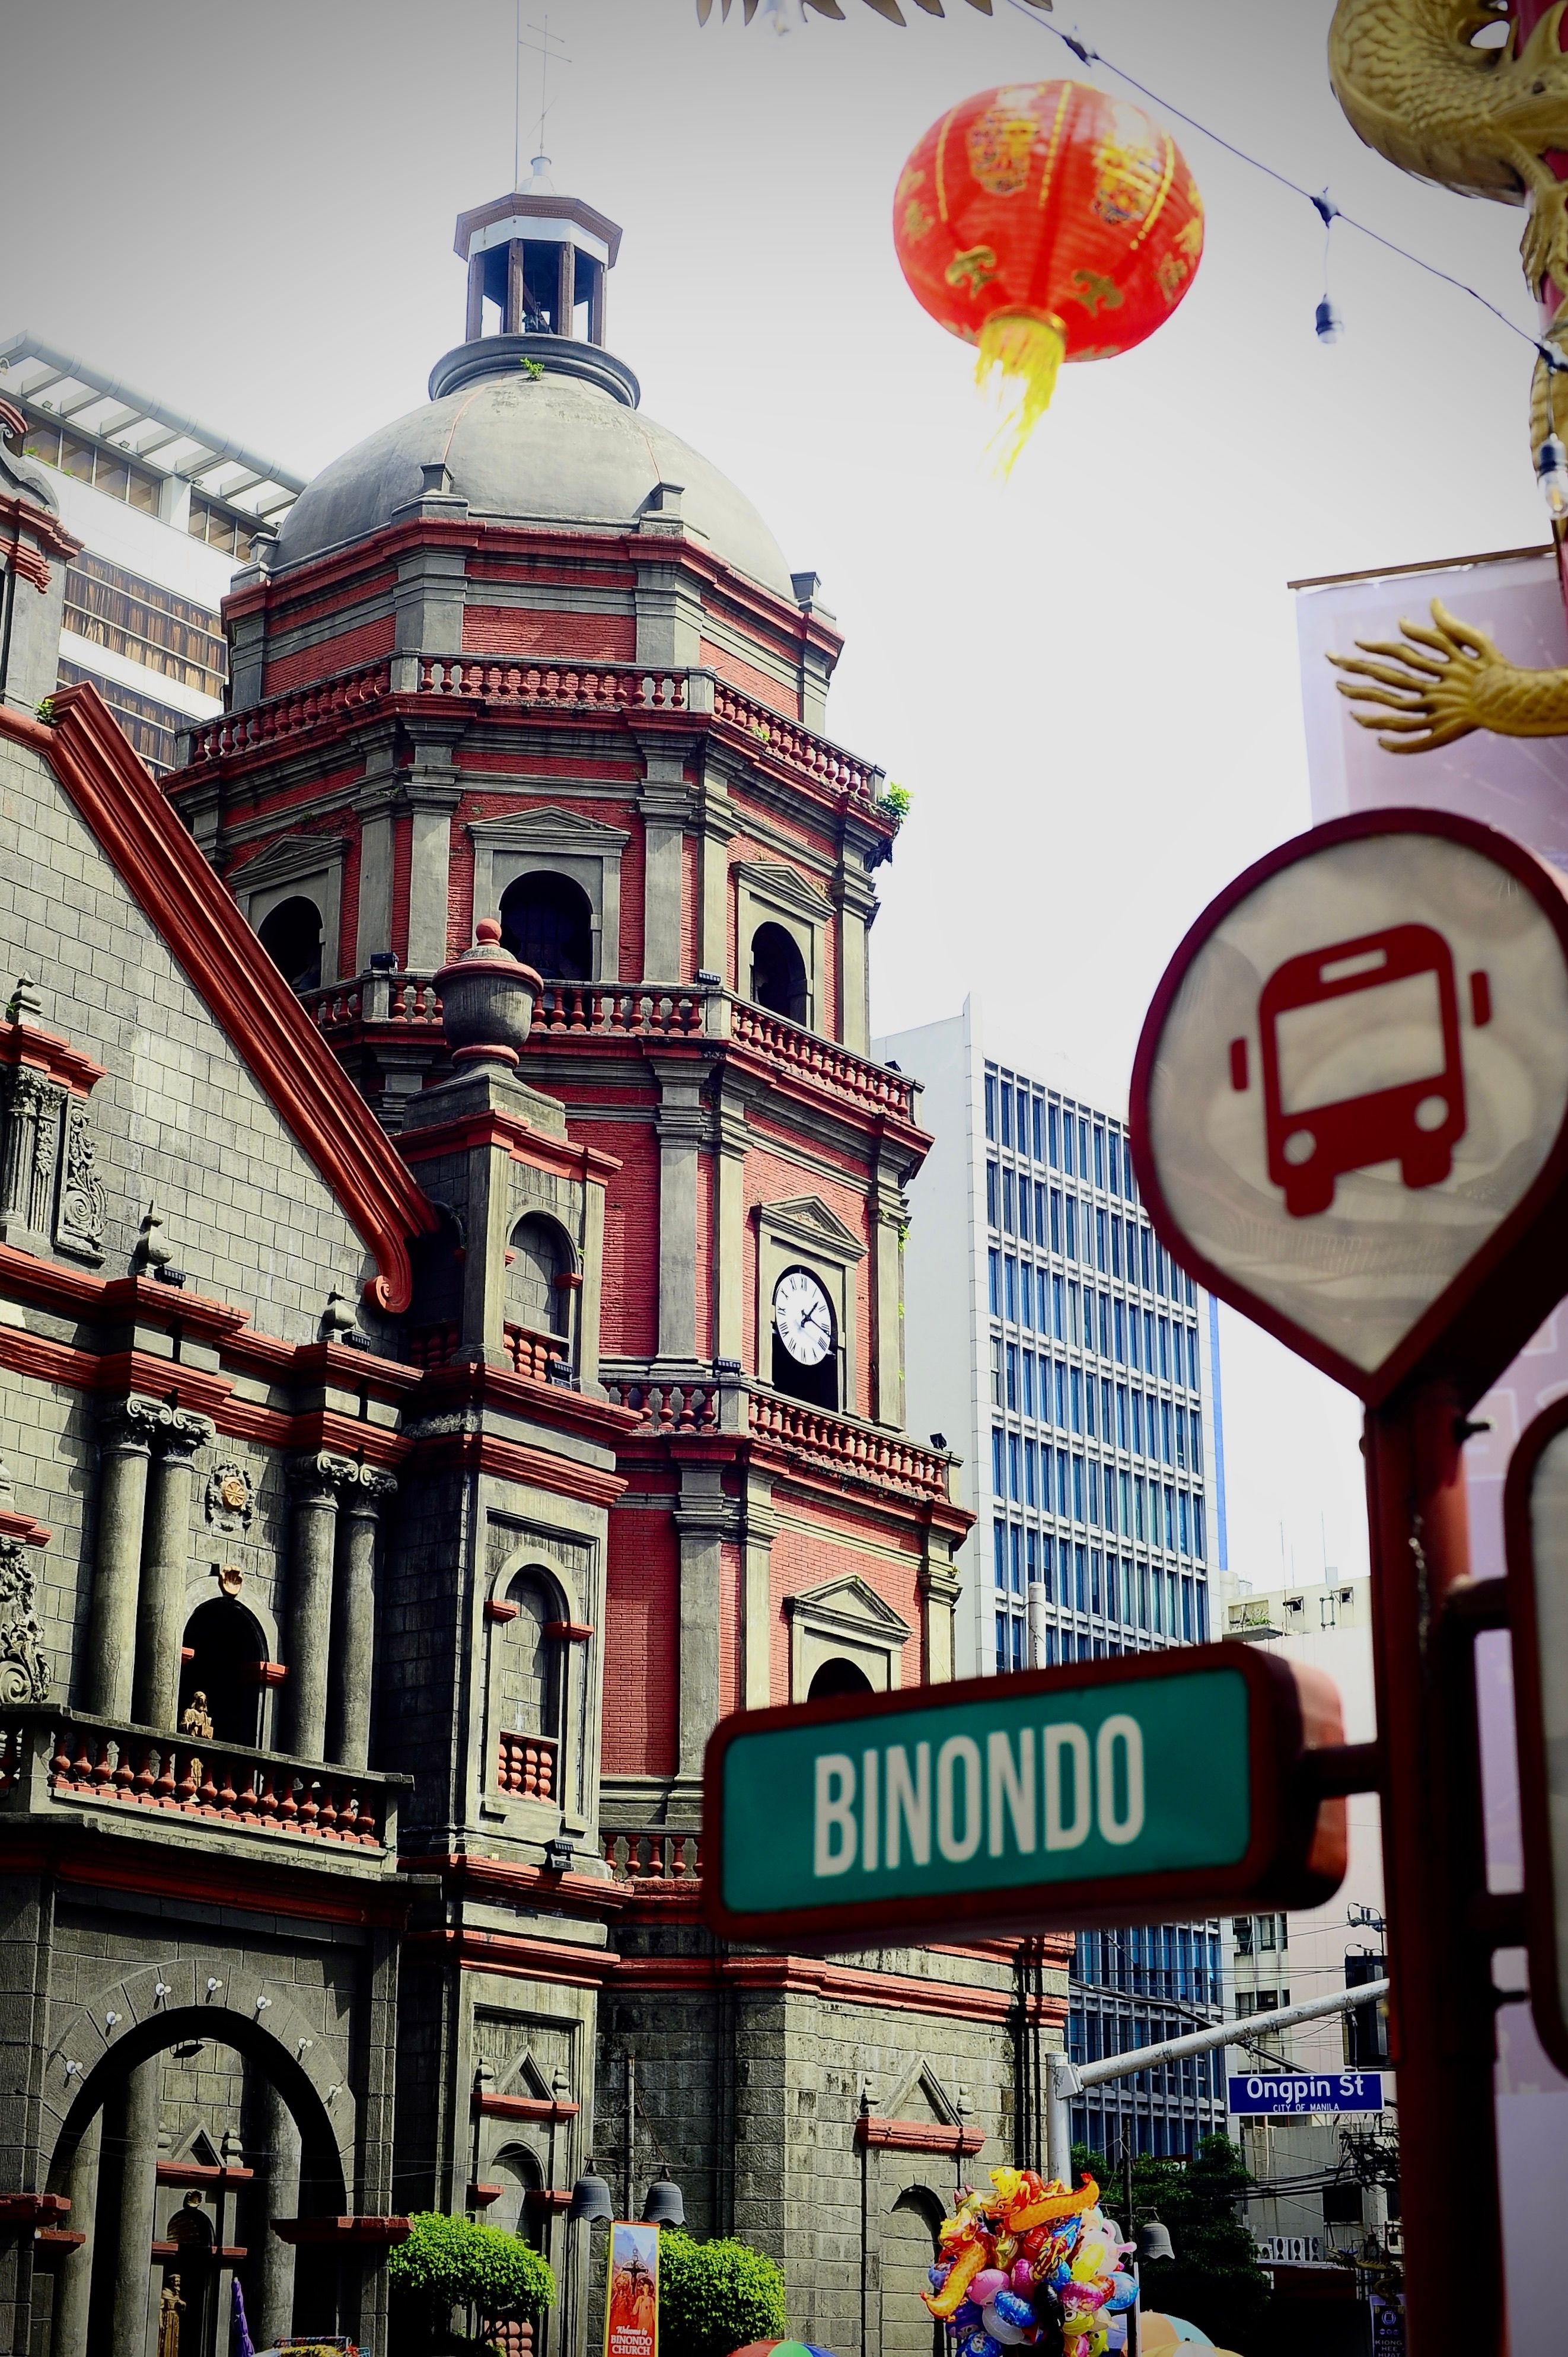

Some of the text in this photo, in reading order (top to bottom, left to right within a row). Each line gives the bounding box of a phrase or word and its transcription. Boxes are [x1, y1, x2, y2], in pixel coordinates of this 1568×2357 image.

[814, 1713, 1145, 1878] BINONDO
[1247, 2075, 1364, 2104] Ongpin St
[1273, 2103, 1340, 2113] CITY OF MANILA
[616, 2324, 648, 2336] Welcome to
[610, 2334, 652, 2346] BINONDO
[611, 2345, 651, 2356] CHURCH
